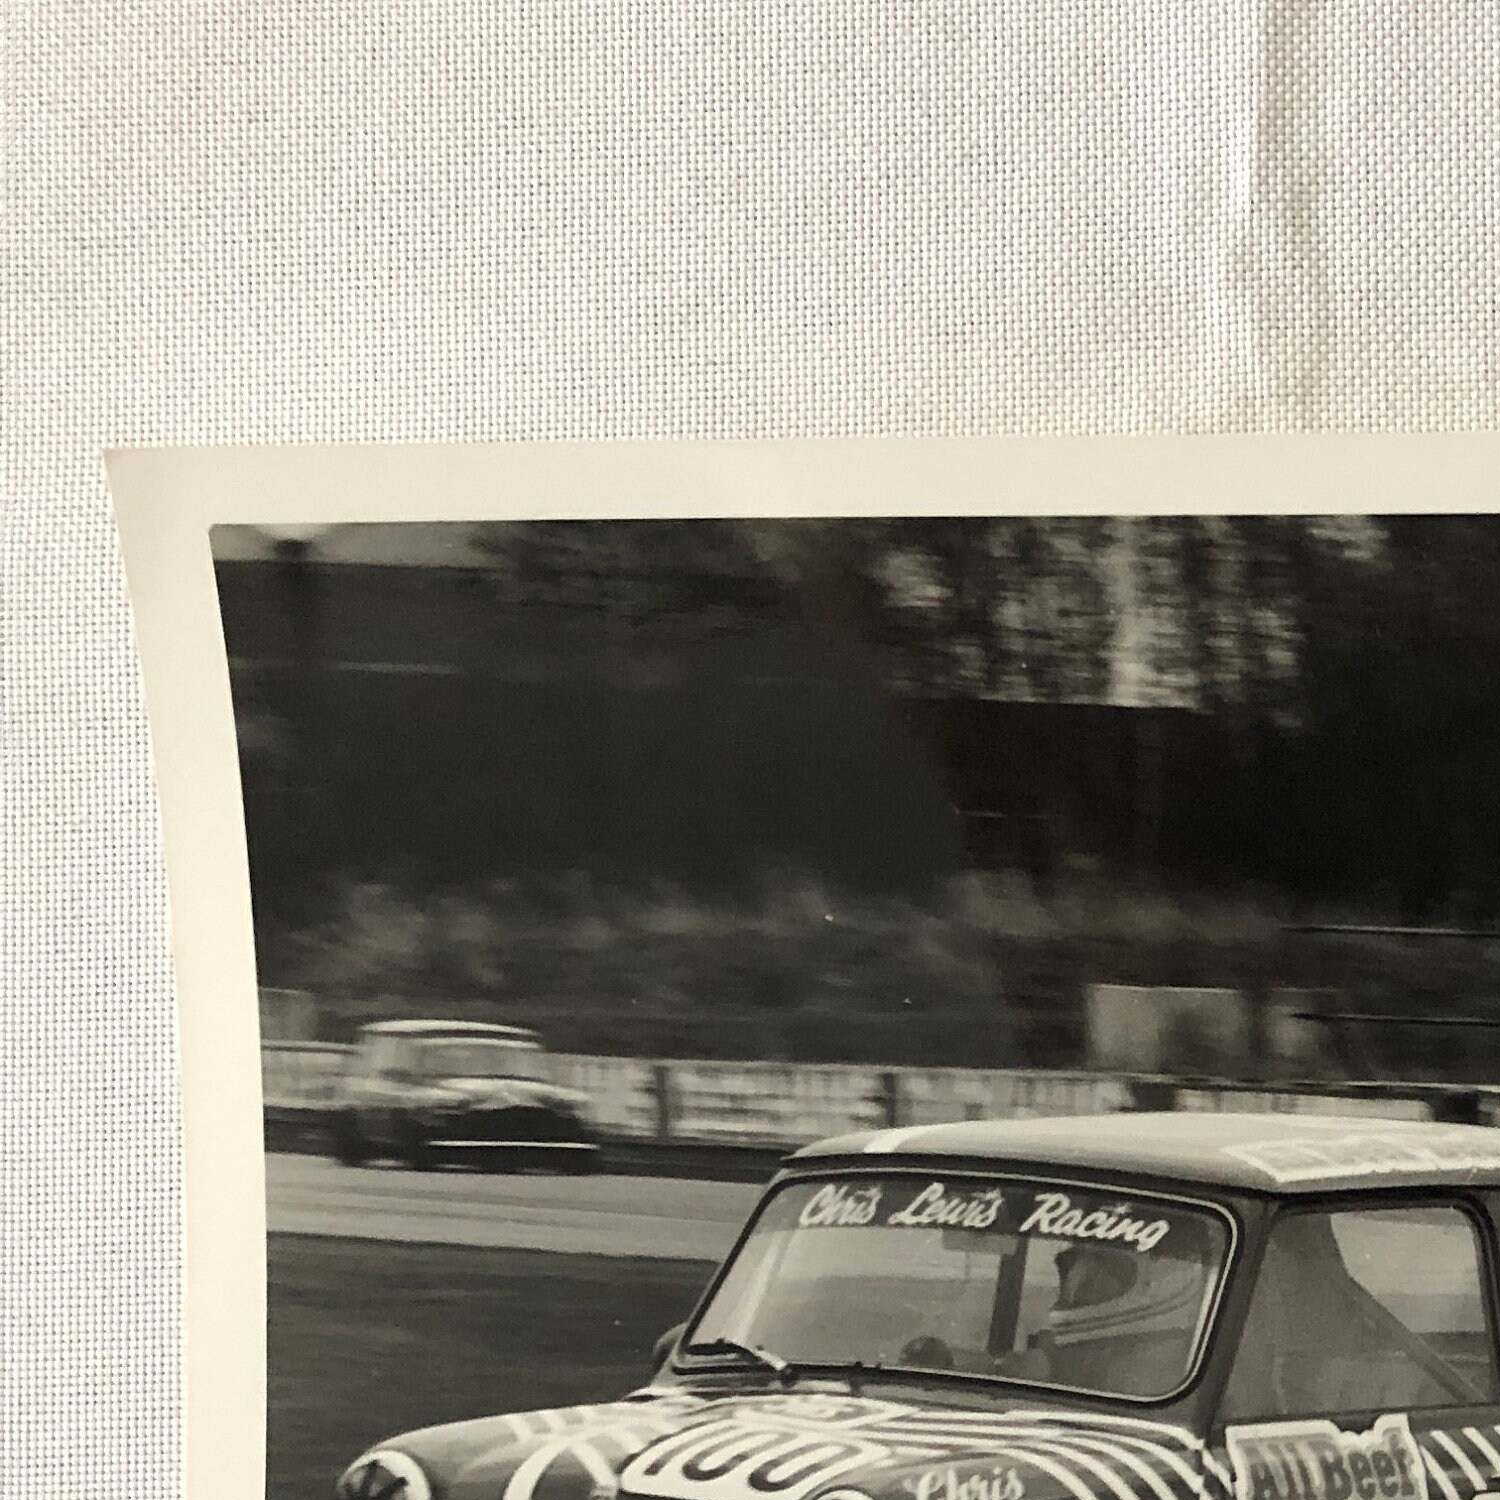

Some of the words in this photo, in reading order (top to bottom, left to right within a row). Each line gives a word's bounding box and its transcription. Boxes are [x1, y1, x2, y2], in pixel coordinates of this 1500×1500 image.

[800, 1182, 883, 1227] Chris
[888, 1181, 1004, 1229] Lewis
[1019, 1192, 1171, 1252] Racing
[643, 1422, 864, 1493] 100
